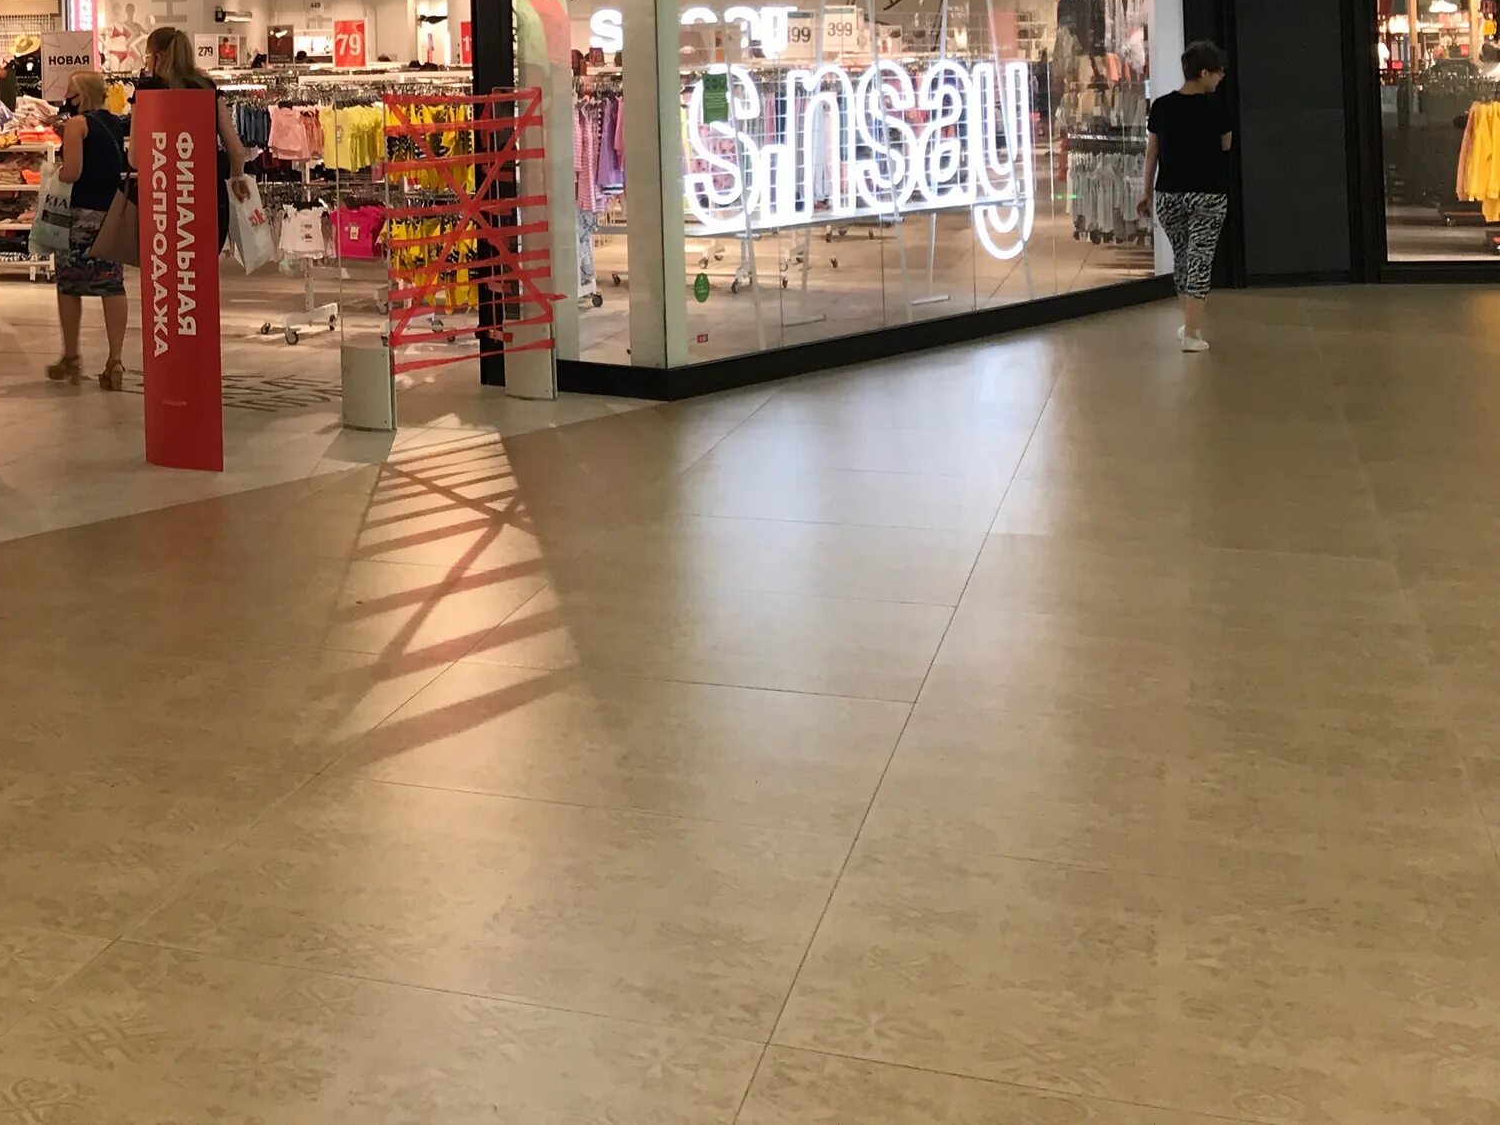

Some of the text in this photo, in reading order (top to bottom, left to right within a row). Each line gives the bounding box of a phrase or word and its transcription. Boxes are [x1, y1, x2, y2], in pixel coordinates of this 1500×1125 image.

[827, 22, 853, 36] 399
[198, 46, 213, 56] 279
[336, 34, 361, 55] 79
[48, 55, 90, 66] НОВАЯ
[175, 131, 196, 336] ФИНАЛЬНАЯ
[151, 132, 169, 357] РАСПРОДАЖА
